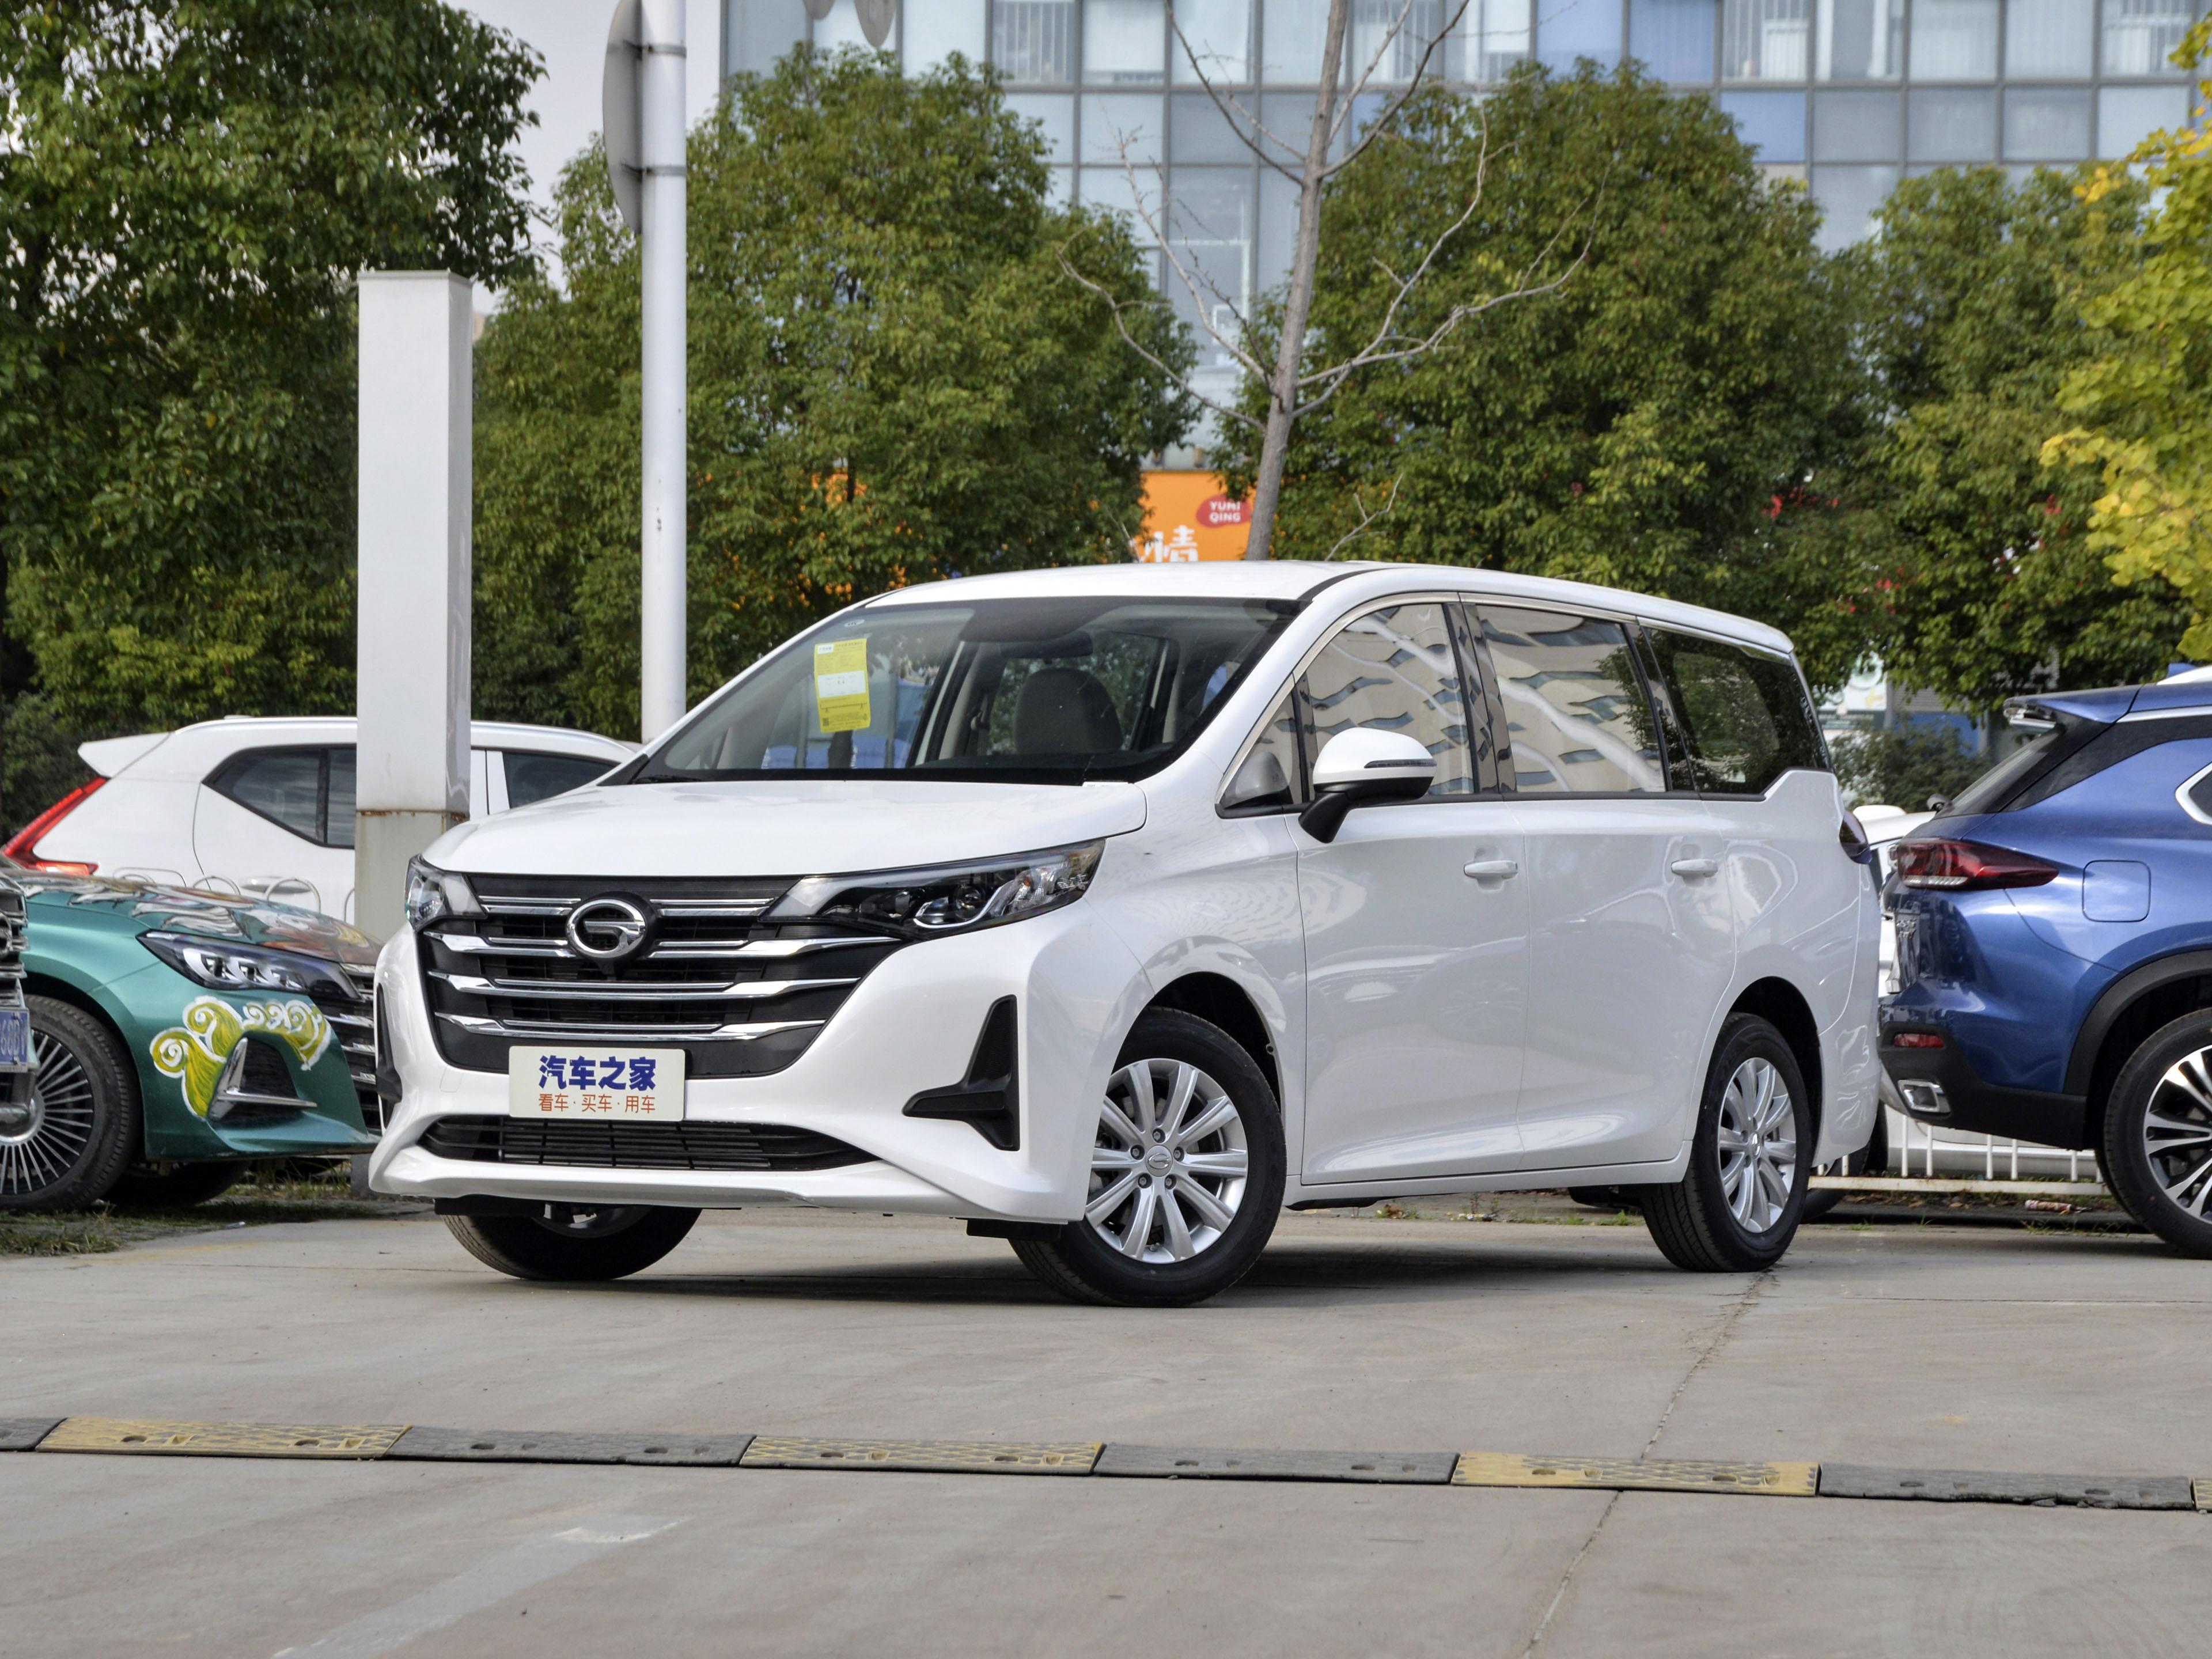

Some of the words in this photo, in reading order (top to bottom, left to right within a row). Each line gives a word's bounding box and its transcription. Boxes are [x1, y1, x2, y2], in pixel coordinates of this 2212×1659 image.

[1209, 512, 1241, 524] QING
[539, 1055, 656, 1091] 汽车之家
